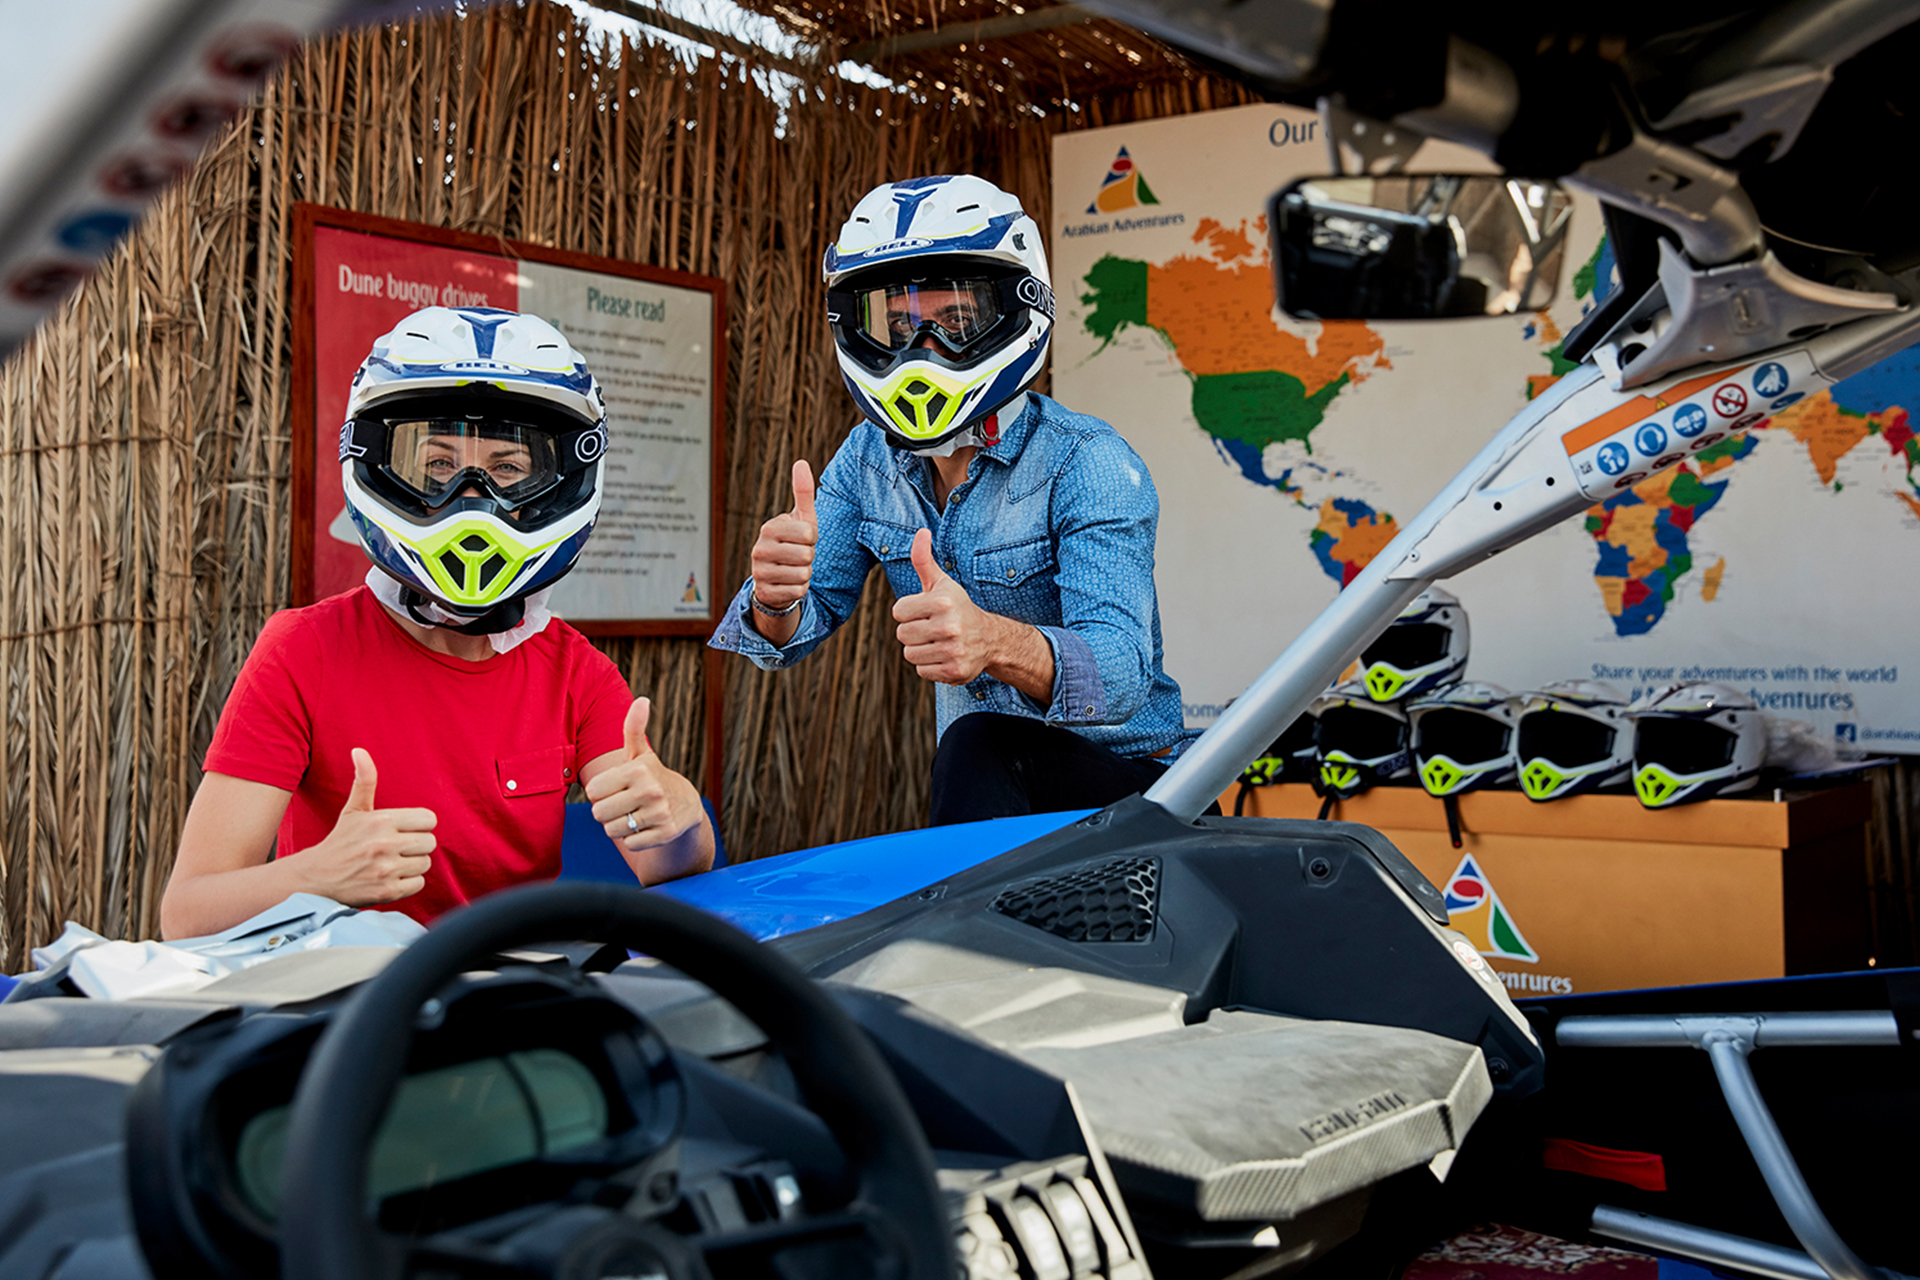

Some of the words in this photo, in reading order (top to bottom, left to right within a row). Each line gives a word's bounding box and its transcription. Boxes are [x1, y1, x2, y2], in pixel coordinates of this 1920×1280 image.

[1269, 118, 1318, 147] Our
[1062, 223, 1110, 239] Arabian
[1112, 213, 1186, 233] Adventures
[873, 238, 922, 254] BELL
[338, 263, 384, 298] Dune
[387, 271, 439, 310] buggy
[441, 281, 489, 307] drives
[587, 286, 632, 319] Please
[634, 297, 666, 324] read
[454, 361, 517, 373] BELL
[1591, 662, 1634, 680] Share
[1637, 666, 1675, 683] your
[1679, 663, 1767, 682] adventures
[1770, 664, 1810, 682] with
[1813, 664, 1842, 683] the
[1845, 664, 1899, 684] world
[1497, 970, 1573, 994] entures
